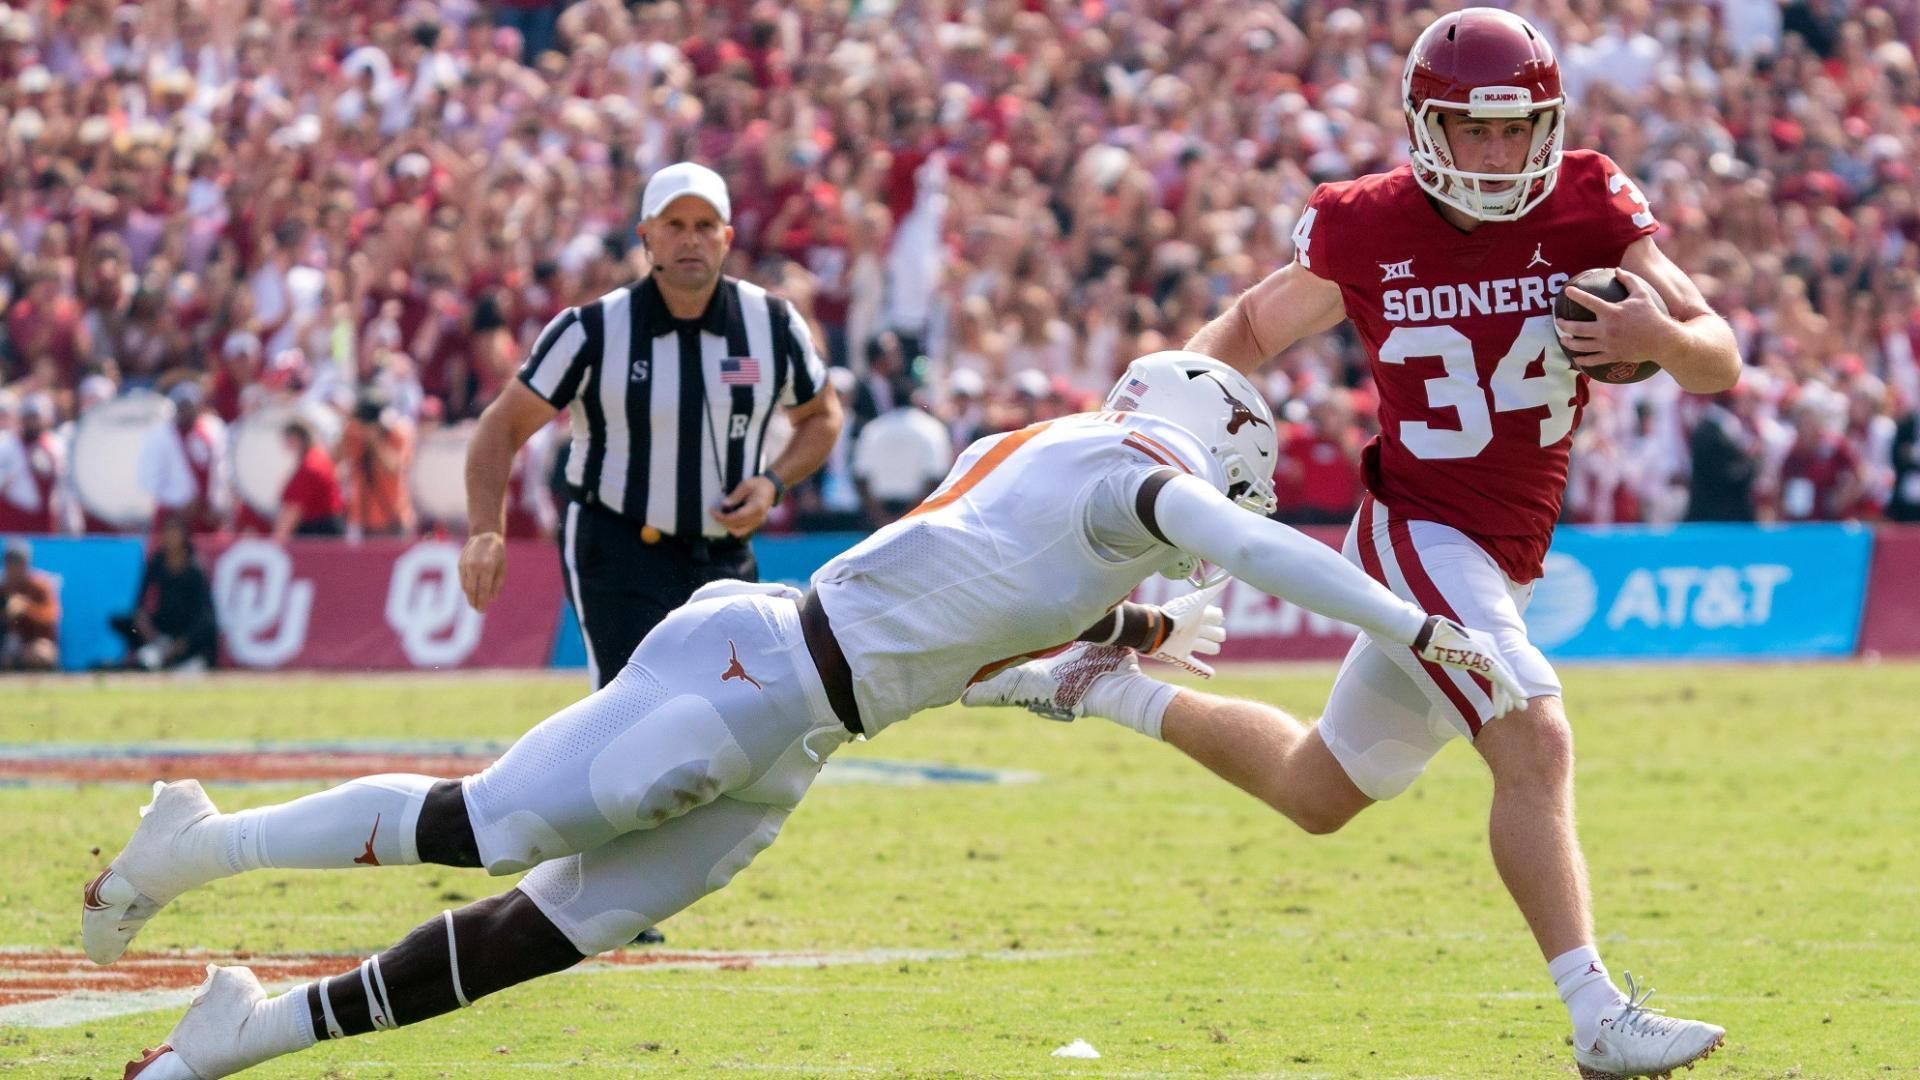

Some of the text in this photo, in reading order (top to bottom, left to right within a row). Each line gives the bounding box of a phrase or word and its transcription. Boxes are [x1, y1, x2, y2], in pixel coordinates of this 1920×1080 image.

[1484, 93, 1519, 102] OKLAHOMA
[1378, 258, 1416, 283] XII
[1382, 272, 1570, 322] SOONERS
[631, 360, 649, 382] S
[1378, 314, 1581, 461] 34
[730, 413, 748, 439] R
[213, 538, 315, 668] OU
[384, 540, 486, 668] OU
[1606, 563, 1794, 632] AT&T
[1434, 646, 1495, 672] TEXAS
